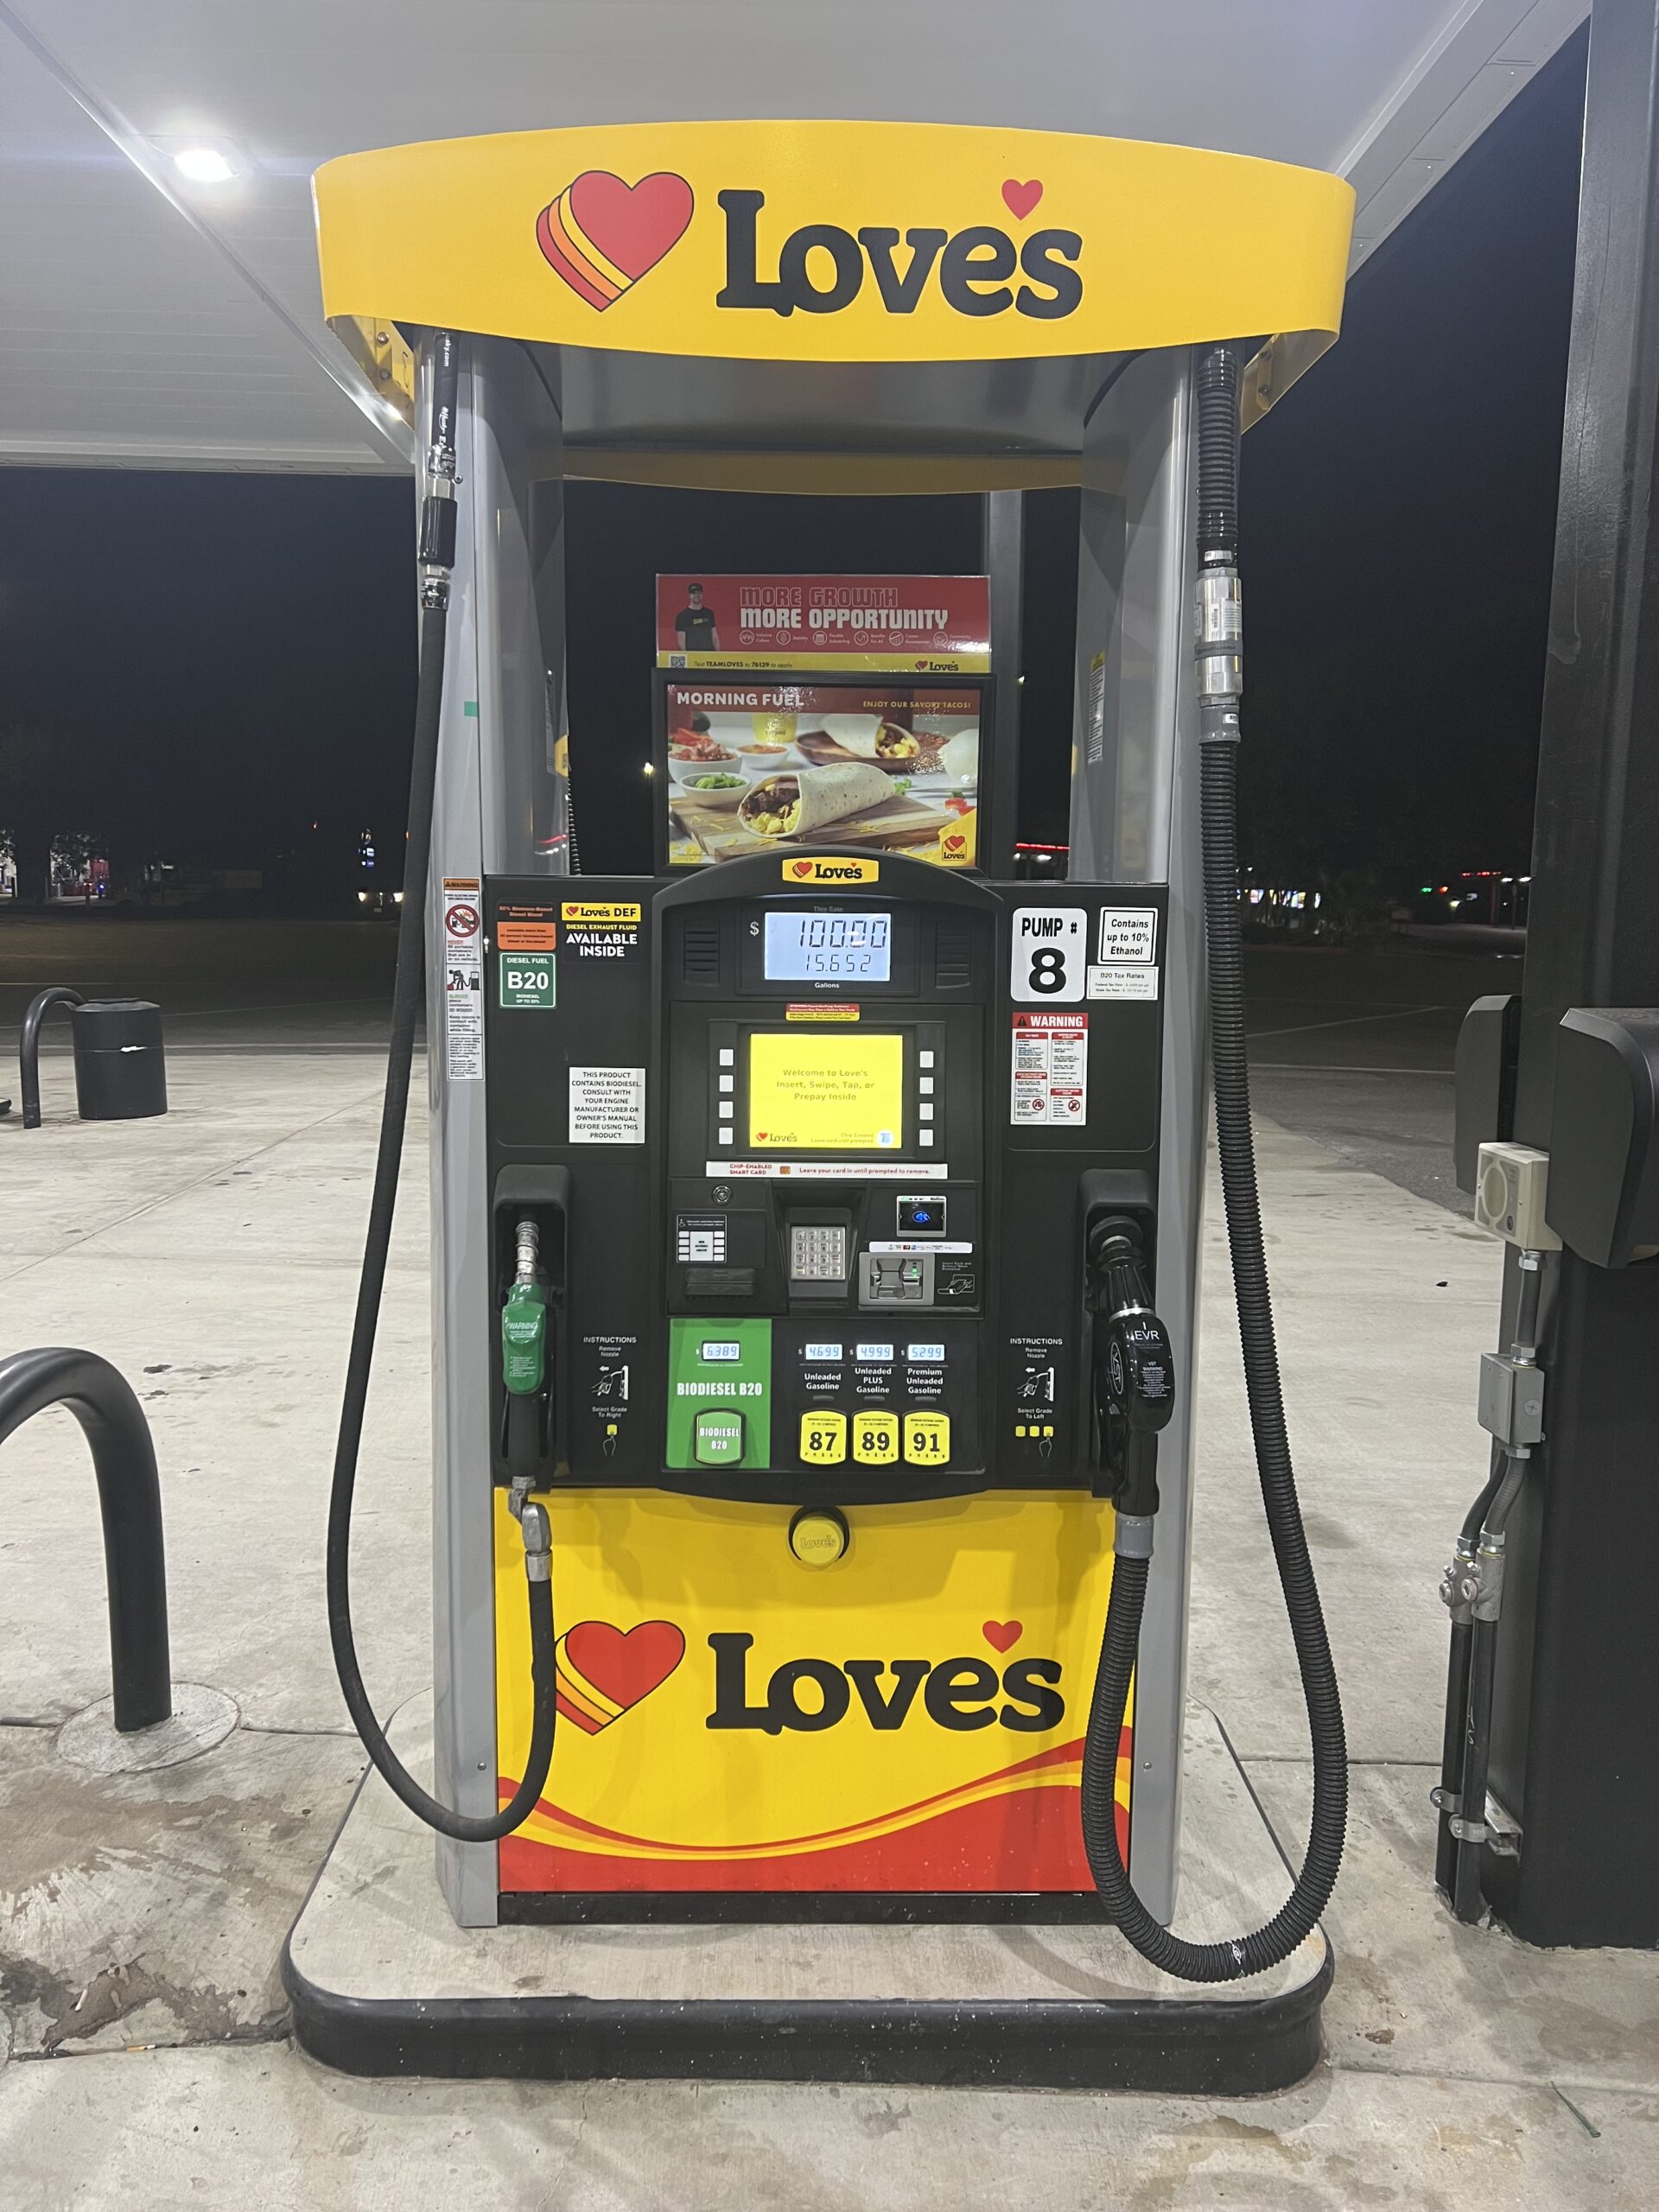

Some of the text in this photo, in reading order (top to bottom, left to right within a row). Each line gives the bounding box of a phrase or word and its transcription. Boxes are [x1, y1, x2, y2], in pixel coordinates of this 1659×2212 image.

[740, 587, 898, 607] MORE GROWTH
[741, 608, 949, 629] MORE OPPORTUNITY
[677, 692, 804, 707] MORNING FUEL
[613, 907, 637, 917] DEF
[749, 921, 760, 937] $
[1021, 918, 1078, 938] PUMP #
[1111, 918, 1149, 928] Contains
[566, 933, 638, 944] AVAILABLE
[1107, 932, 1149, 943] up to 10%
[580, 946, 625, 957] INSIDE
[1110, 946, 1143, 956] Ethanol
[806, 954, 872, 972] 15.652
[1028, 947, 1067, 994] 8
[507, 971, 549, 989] B20
[1030, 1015, 1084, 1027] WARNING
[810, 1081, 840, 1090] Swipe,
[842, 1081, 861, 1090] Tap,
[1135, 1330, 1160, 1340] EVR
[677, 1382, 762, 1395] BIODIESEL B20
[699, 1427, 740, 1437] BIODIESEL
[711, 1440, 727, 1450] B20
[809, 1431, 837, 1452] 87
[861, 1431, 890, 1452] 89
[912, 1432, 940, 1452] 91
